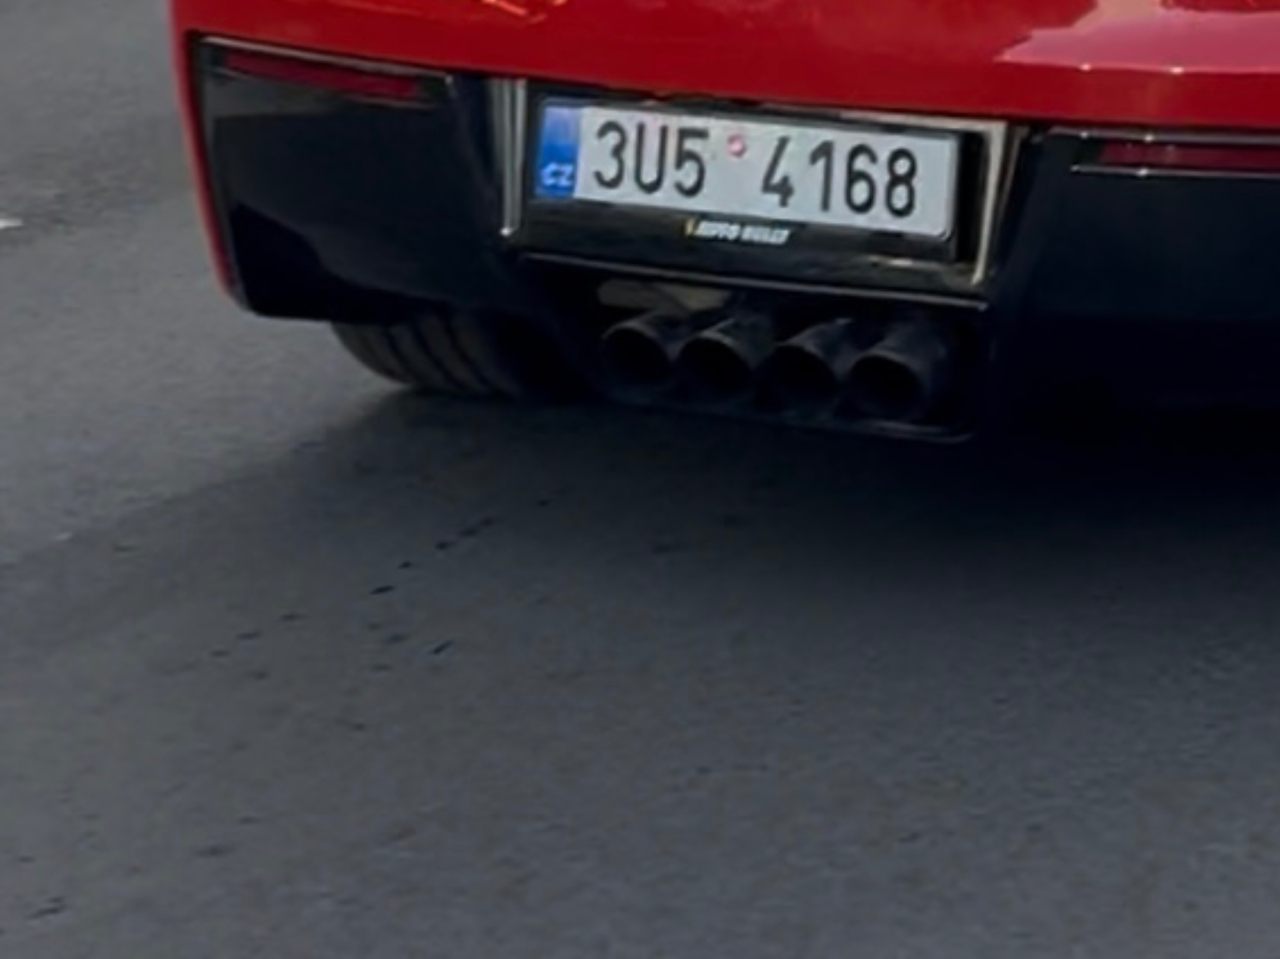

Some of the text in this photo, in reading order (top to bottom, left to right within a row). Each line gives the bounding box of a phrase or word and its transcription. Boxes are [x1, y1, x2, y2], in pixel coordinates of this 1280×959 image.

[541, 163, 574, 186] CZ
[594, 121, 917, 218] 3U5 4168
